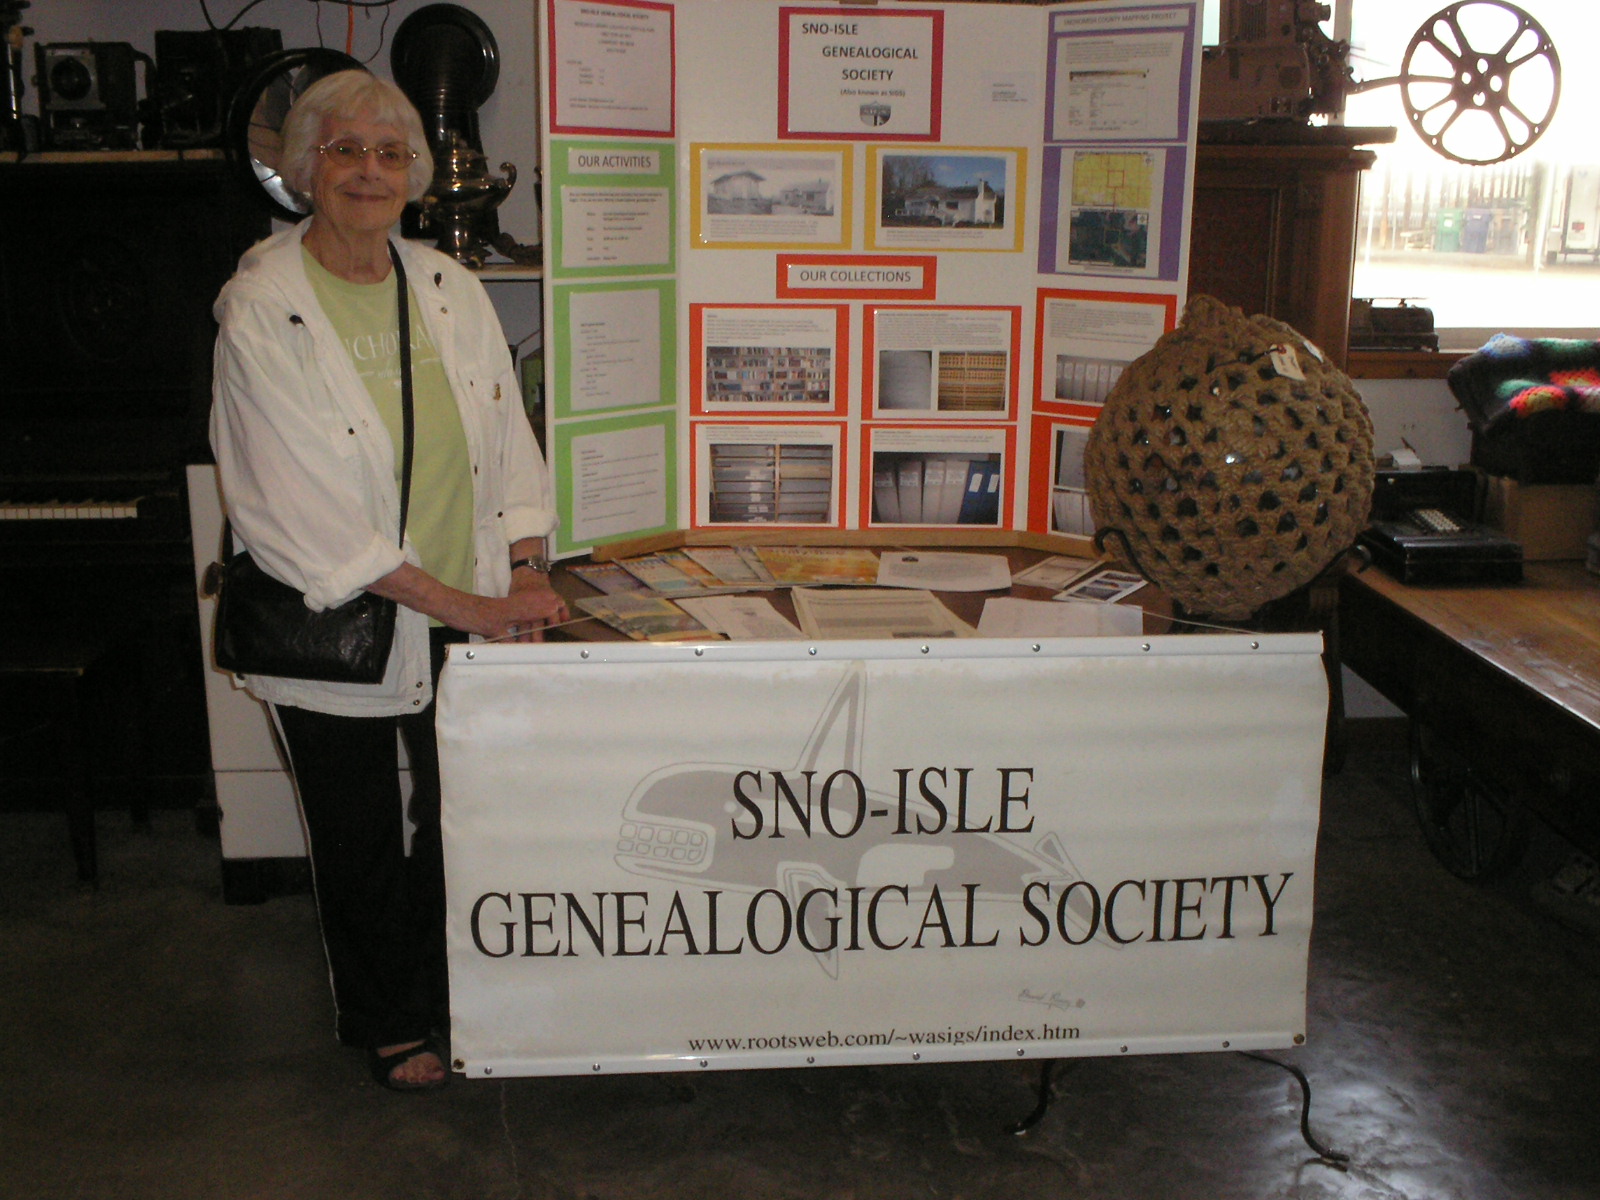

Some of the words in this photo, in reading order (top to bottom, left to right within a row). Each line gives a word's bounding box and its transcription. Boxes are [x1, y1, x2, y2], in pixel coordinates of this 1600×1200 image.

[802, 22, 859, 35] SNO-ISLE
[822, 45, 918, 60] GENEALOGICAL
[841, 68, 894, 81] SOCIETY
[858, 88, 879, 96] known
[578, 154, 600, 168] OUR
[602, 154, 652, 168] ACTIVITIES
[800, 270, 828, 282] OUR
[830, 270, 911, 283] COLLECTIONS
[733, 767, 1035, 840] SNO-ISLE
[470, 883, 1000, 958] GENEALOGICAL
[1020, 872, 1294, 947] SOCIETY
[688, 1024, 1080, 1052] www.rootsweb.com/~wasigs/index.htm
